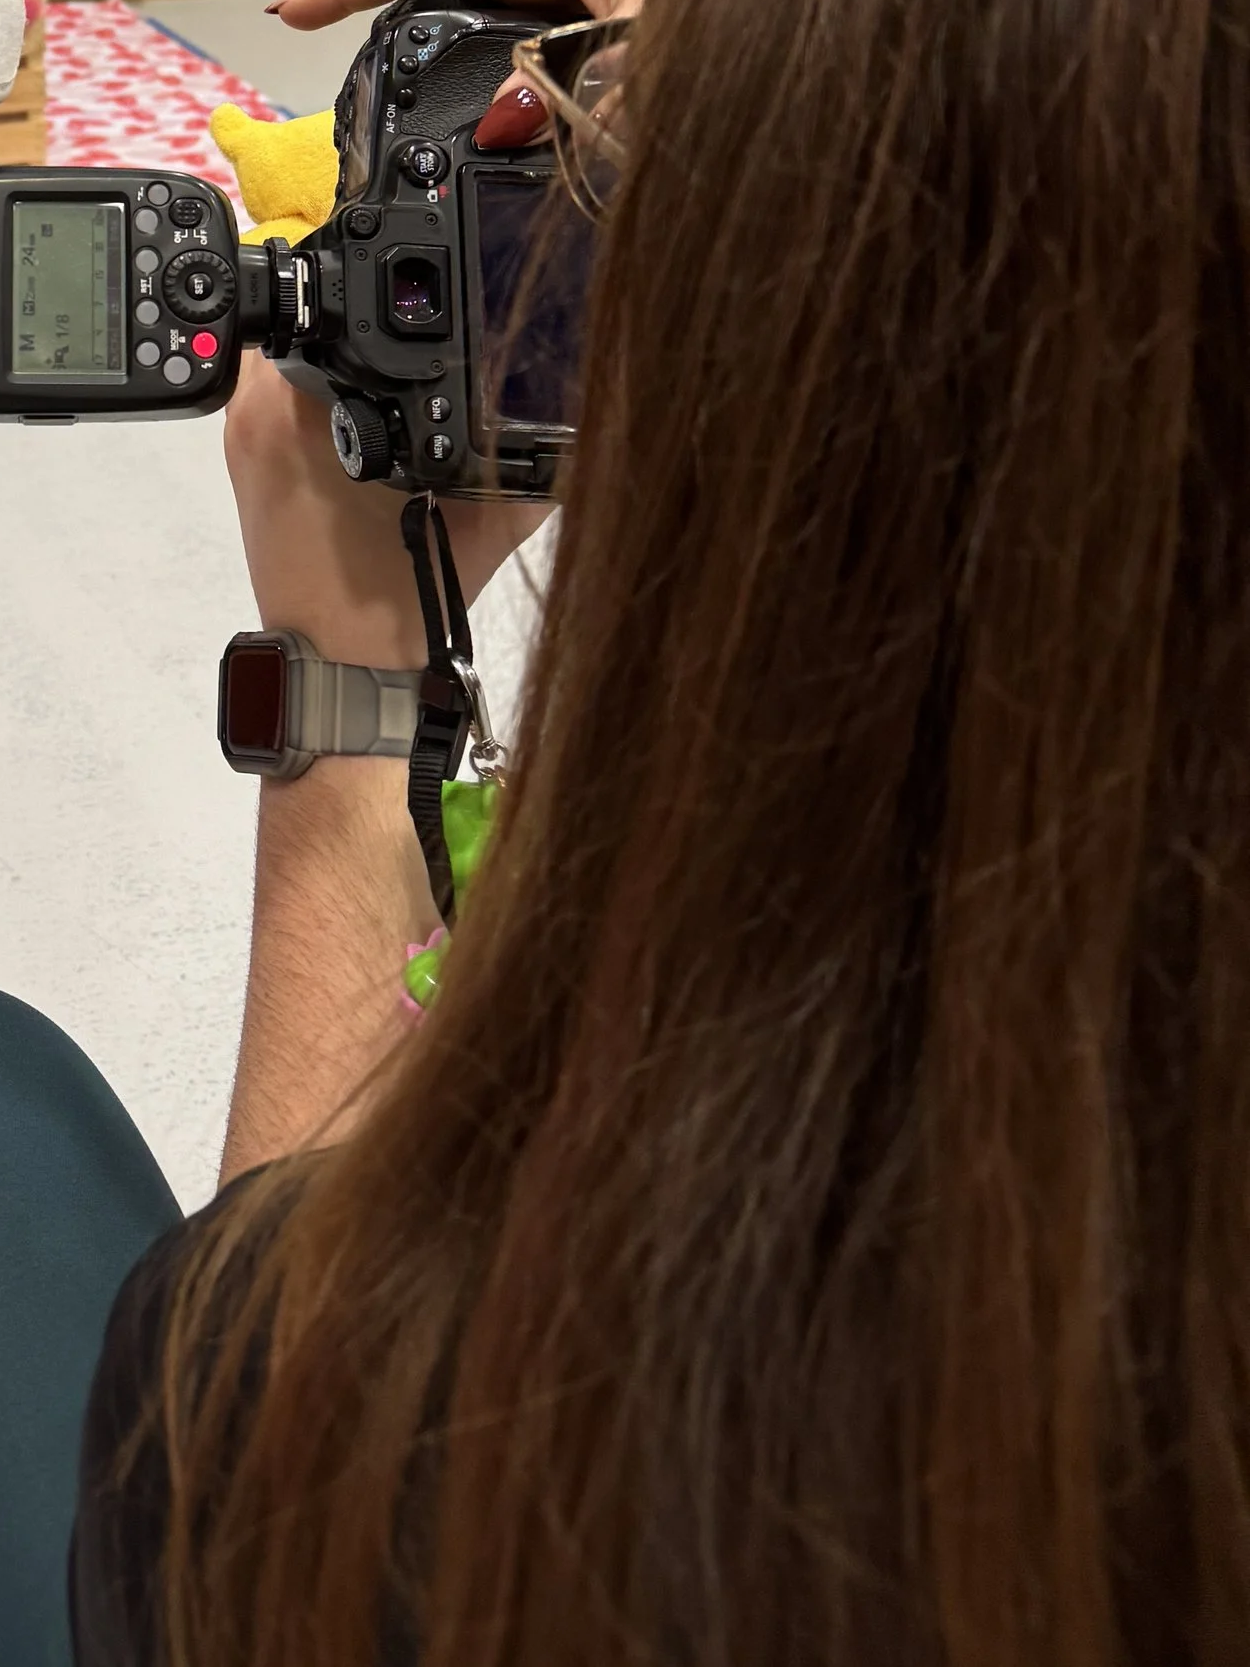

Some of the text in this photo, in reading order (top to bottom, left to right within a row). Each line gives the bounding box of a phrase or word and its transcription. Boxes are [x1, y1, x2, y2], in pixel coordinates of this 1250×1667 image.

[386, 103, 397, 134] AF-ON
[174, 230, 182, 244] ON
[200, 229, 208, 246] OFF
[140, 278, 148, 294] RST
[194, 278, 204, 295] SET
[55, 314, 70, 339] 1/8
[19, 334, 36, 352] M
[433, 435, 443, 459] MENU
